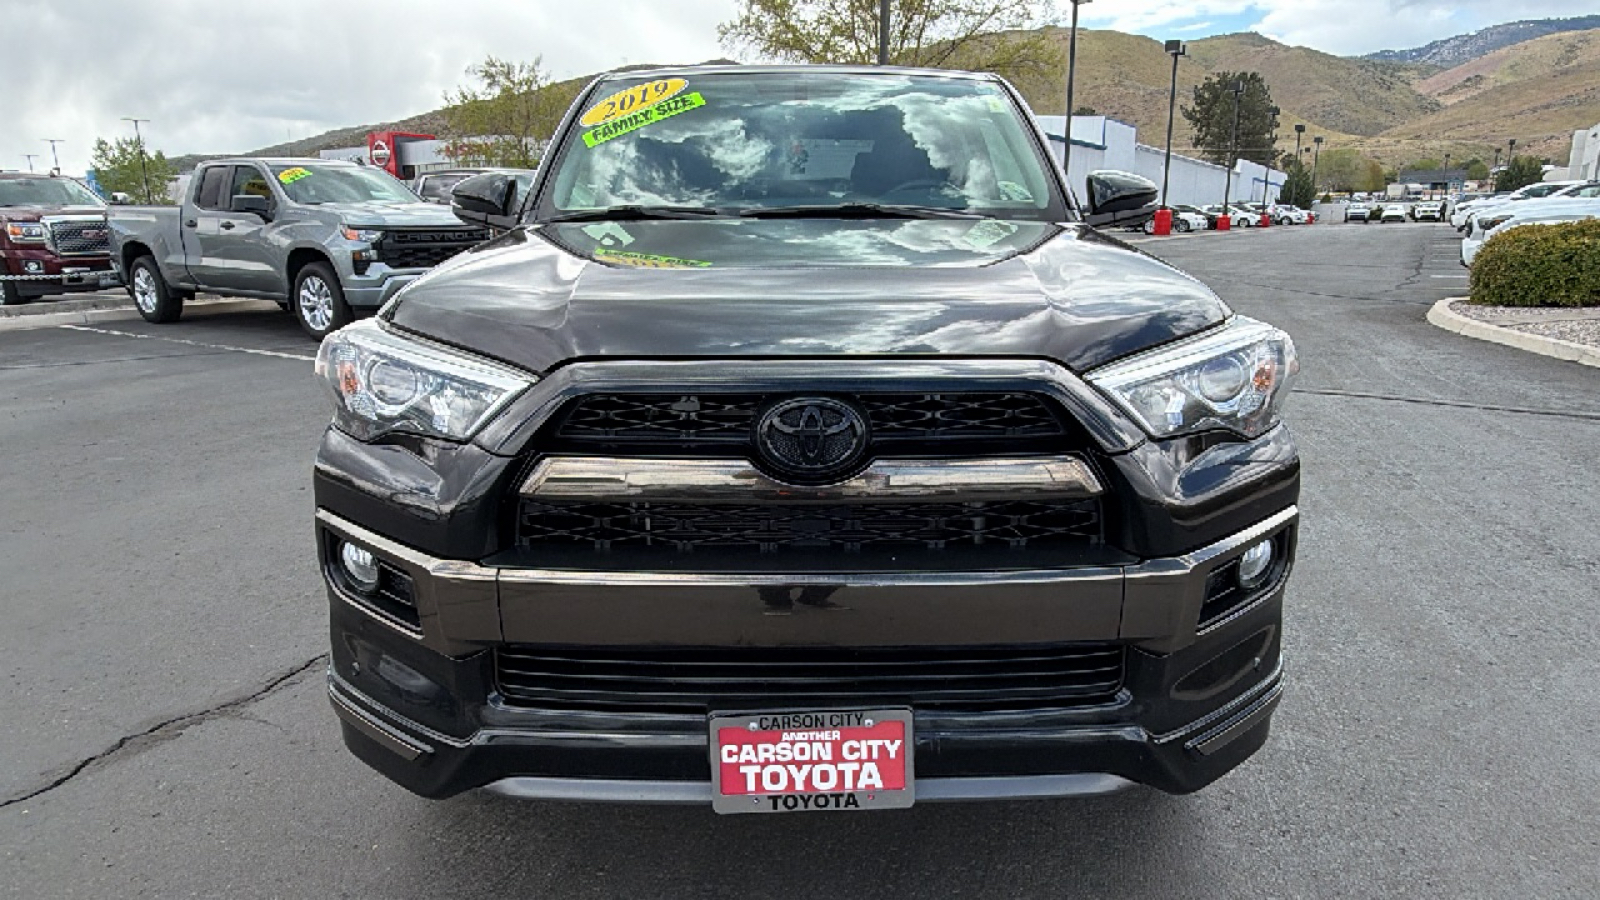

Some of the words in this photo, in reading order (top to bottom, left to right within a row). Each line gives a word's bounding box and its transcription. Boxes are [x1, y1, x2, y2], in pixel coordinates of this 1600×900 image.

[602, 81, 668, 120] 2019
[591, 109, 653, 141] FAMILY
[656, 97, 695, 116] SIZE
[394, 230, 488, 242] CHEVROLE
[759, 714, 826, 730] CARSON
[829, 713, 864, 728] CITY
[781, 730, 841, 741] ANOTHER
[720, 742, 832, 763] CARSON
[842, 739, 902, 761] CITY
[739, 762, 884, 791] TOYOTA
[767, 793, 860, 811] TOYOTA
